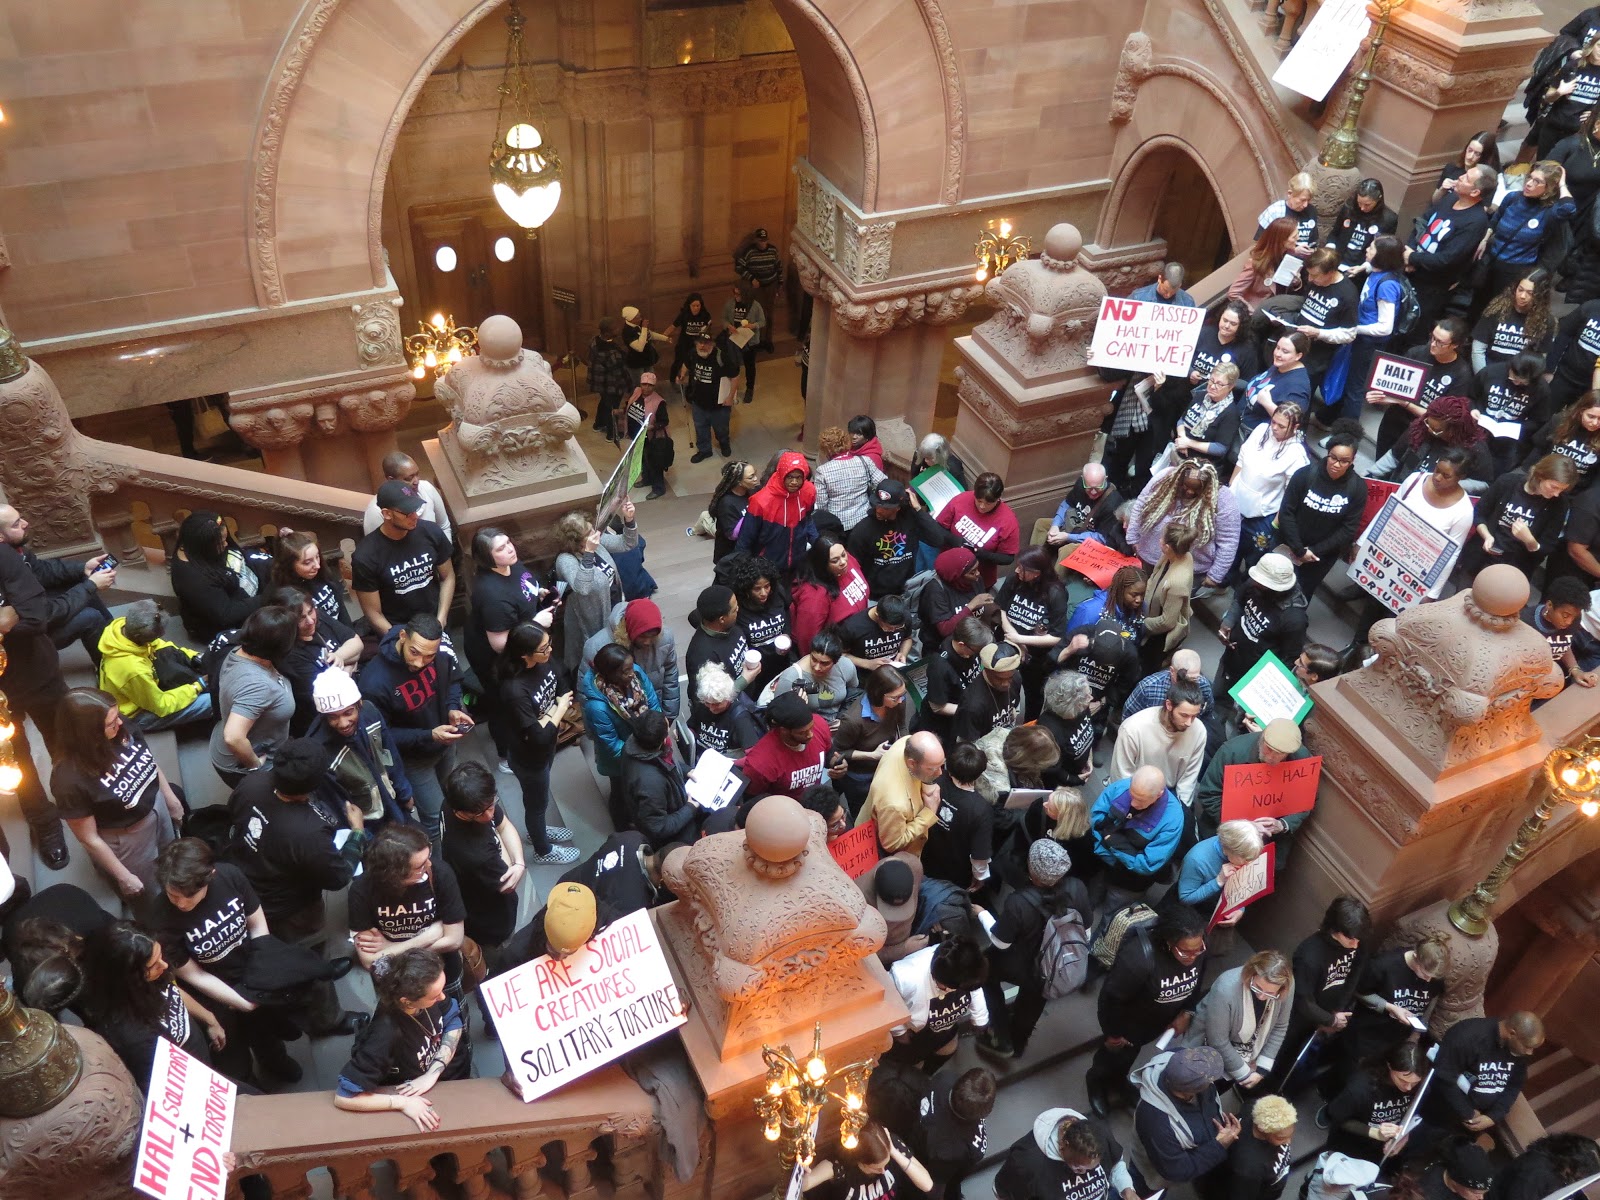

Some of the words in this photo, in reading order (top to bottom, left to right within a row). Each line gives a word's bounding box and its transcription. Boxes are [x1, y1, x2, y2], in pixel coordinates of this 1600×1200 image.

[1101, 299, 1142, 321] NJ
[1151, 305, 1198, 324] PASSED
[1156, 329, 1183, 342] WHY
[1155, 345, 1193, 366] WE?
[1384, 363, 1415, 381] HALT
[1376, 378, 1415, 394] SOLITARY
[960, 514, 986, 535] CITIZEN
[390, 552, 433, 576] H.A.L.T.
[393, 563, 434, 585] SOLITARY
[1368, 545, 1393, 567] NEW
[1397, 568, 1426, 596] YORK
[1362, 558, 1385, 579] END
[1389, 578, 1413, 602] THIS
[1010, 603, 1043, 621] SOLITARY
[1013, 594, 1045, 614] H.A.L.T.
[749, 614, 785, 631] H.A.L.T.
[1008, 610, 1037, 625] CONFINEMEN
[750, 623, 785, 639] SOLITARY
[865, 632, 901, 647] H.A.L.T.
[865, 641, 901, 655] SOLITARY
[1077, 665, 1112, 681] SOLITARY
[534, 671, 556, 703] H.A.L.T.
[318, 694, 344, 712] BPI
[114, 748, 155, 797] SOLITARY
[791, 764, 819, 781] CITIZEN
[1234, 771, 1272, 788] PASS
[1283, 762, 1319, 782] HALT
[1252, 792, 1283, 808] NOW
[832, 825, 873, 858] TORTURE
[378, 897, 436, 917] H.A.L.T.
[186, 897, 245, 942] H.A.L.T.
[379, 911, 436, 928] SOLITARY
[194, 911, 247, 956] SOLITARY
[487, 974, 528, 1018] WE
[535, 959, 582, 999] ARE
[586, 924, 651, 973] SOCIAL
[1160, 967, 1199, 988] H.A.L.T.
[1160, 978, 1198, 998] SOLITARY
[1394, 989, 1430, 999] H.A.L.T.
[535, 967, 636, 1031] CREATURES
[929, 994, 969, 1018] H.A.L.T.
[930, 1003, 970, 1027] SOLITARY
[200, 1073, 231, 1148] TORTURE
[1374, 1096, 1411, 1109] H.A.L.T.
[139, 1100, 175, 1196] HALT
[162, 1042, 190, 1118] SOLITARY
[186, 1146, 221, 1200] END
[884, 1170, 896, 1191] A
[1062, 1164, 1105, 1192] H.A.L.T.
[1066, 1178, 1107, 1200] SOLITARY
